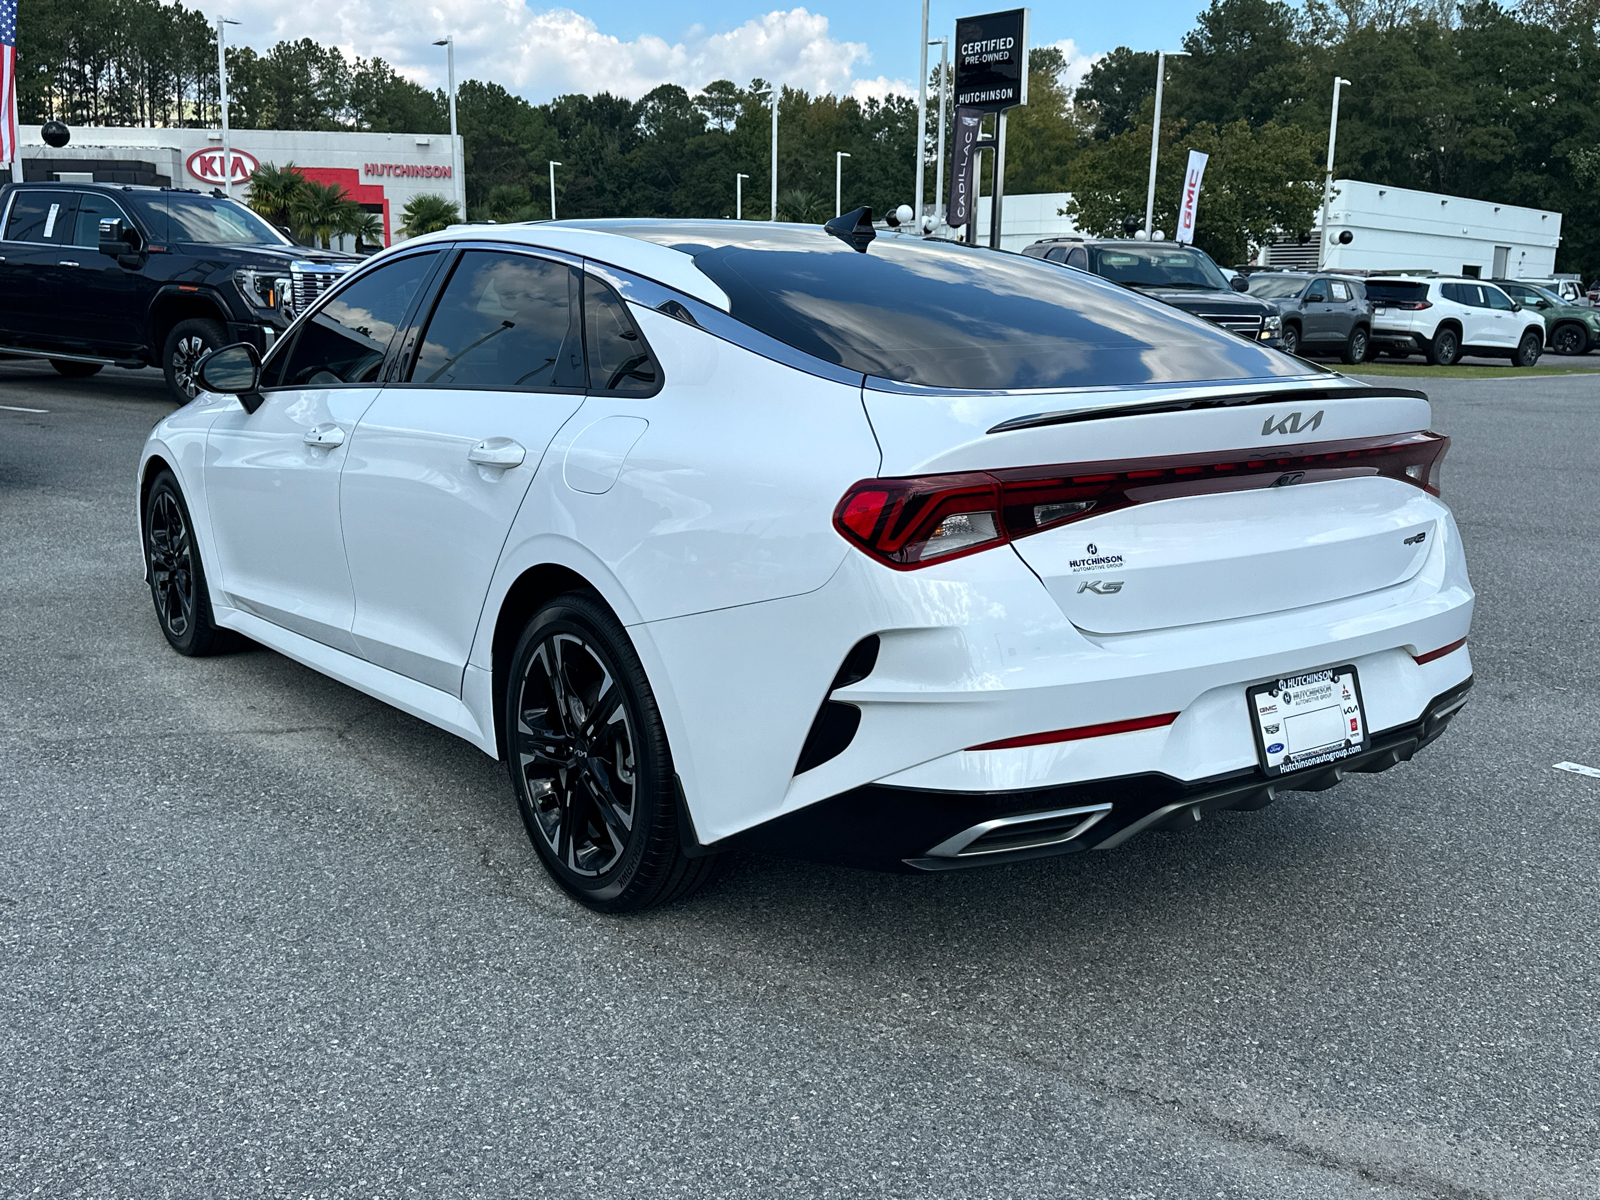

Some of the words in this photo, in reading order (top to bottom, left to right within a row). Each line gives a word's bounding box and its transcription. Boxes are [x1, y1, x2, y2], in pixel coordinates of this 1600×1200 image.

[961, 37, 1014, 55] CERTIFIED
[964, 51, 1009, 65] PRE-OWNED
[959, 88, 1013, 104] HUTCHINSON
[198, 156, 249, 177] KIA
[364, 163, 452, 178] HUTCHINSON
[957, 131, 973, 217] CADILLAC
[1183, 169, 1199, 229] GMC
[1261, 410, 1324, 435] KIA
[1069, 555, 1123, 568] HUTCHINSON
[1073, 564, 1106, 572] AUTOMOTIVE
[1077, 580, 1124, 595] K5
[1287, 669, 1333, 688] HUTCHINSON
[1259, 704, 1278, 713] GMC
[1280, 744, 1362, 774] Hutchinsonautogroup.com
